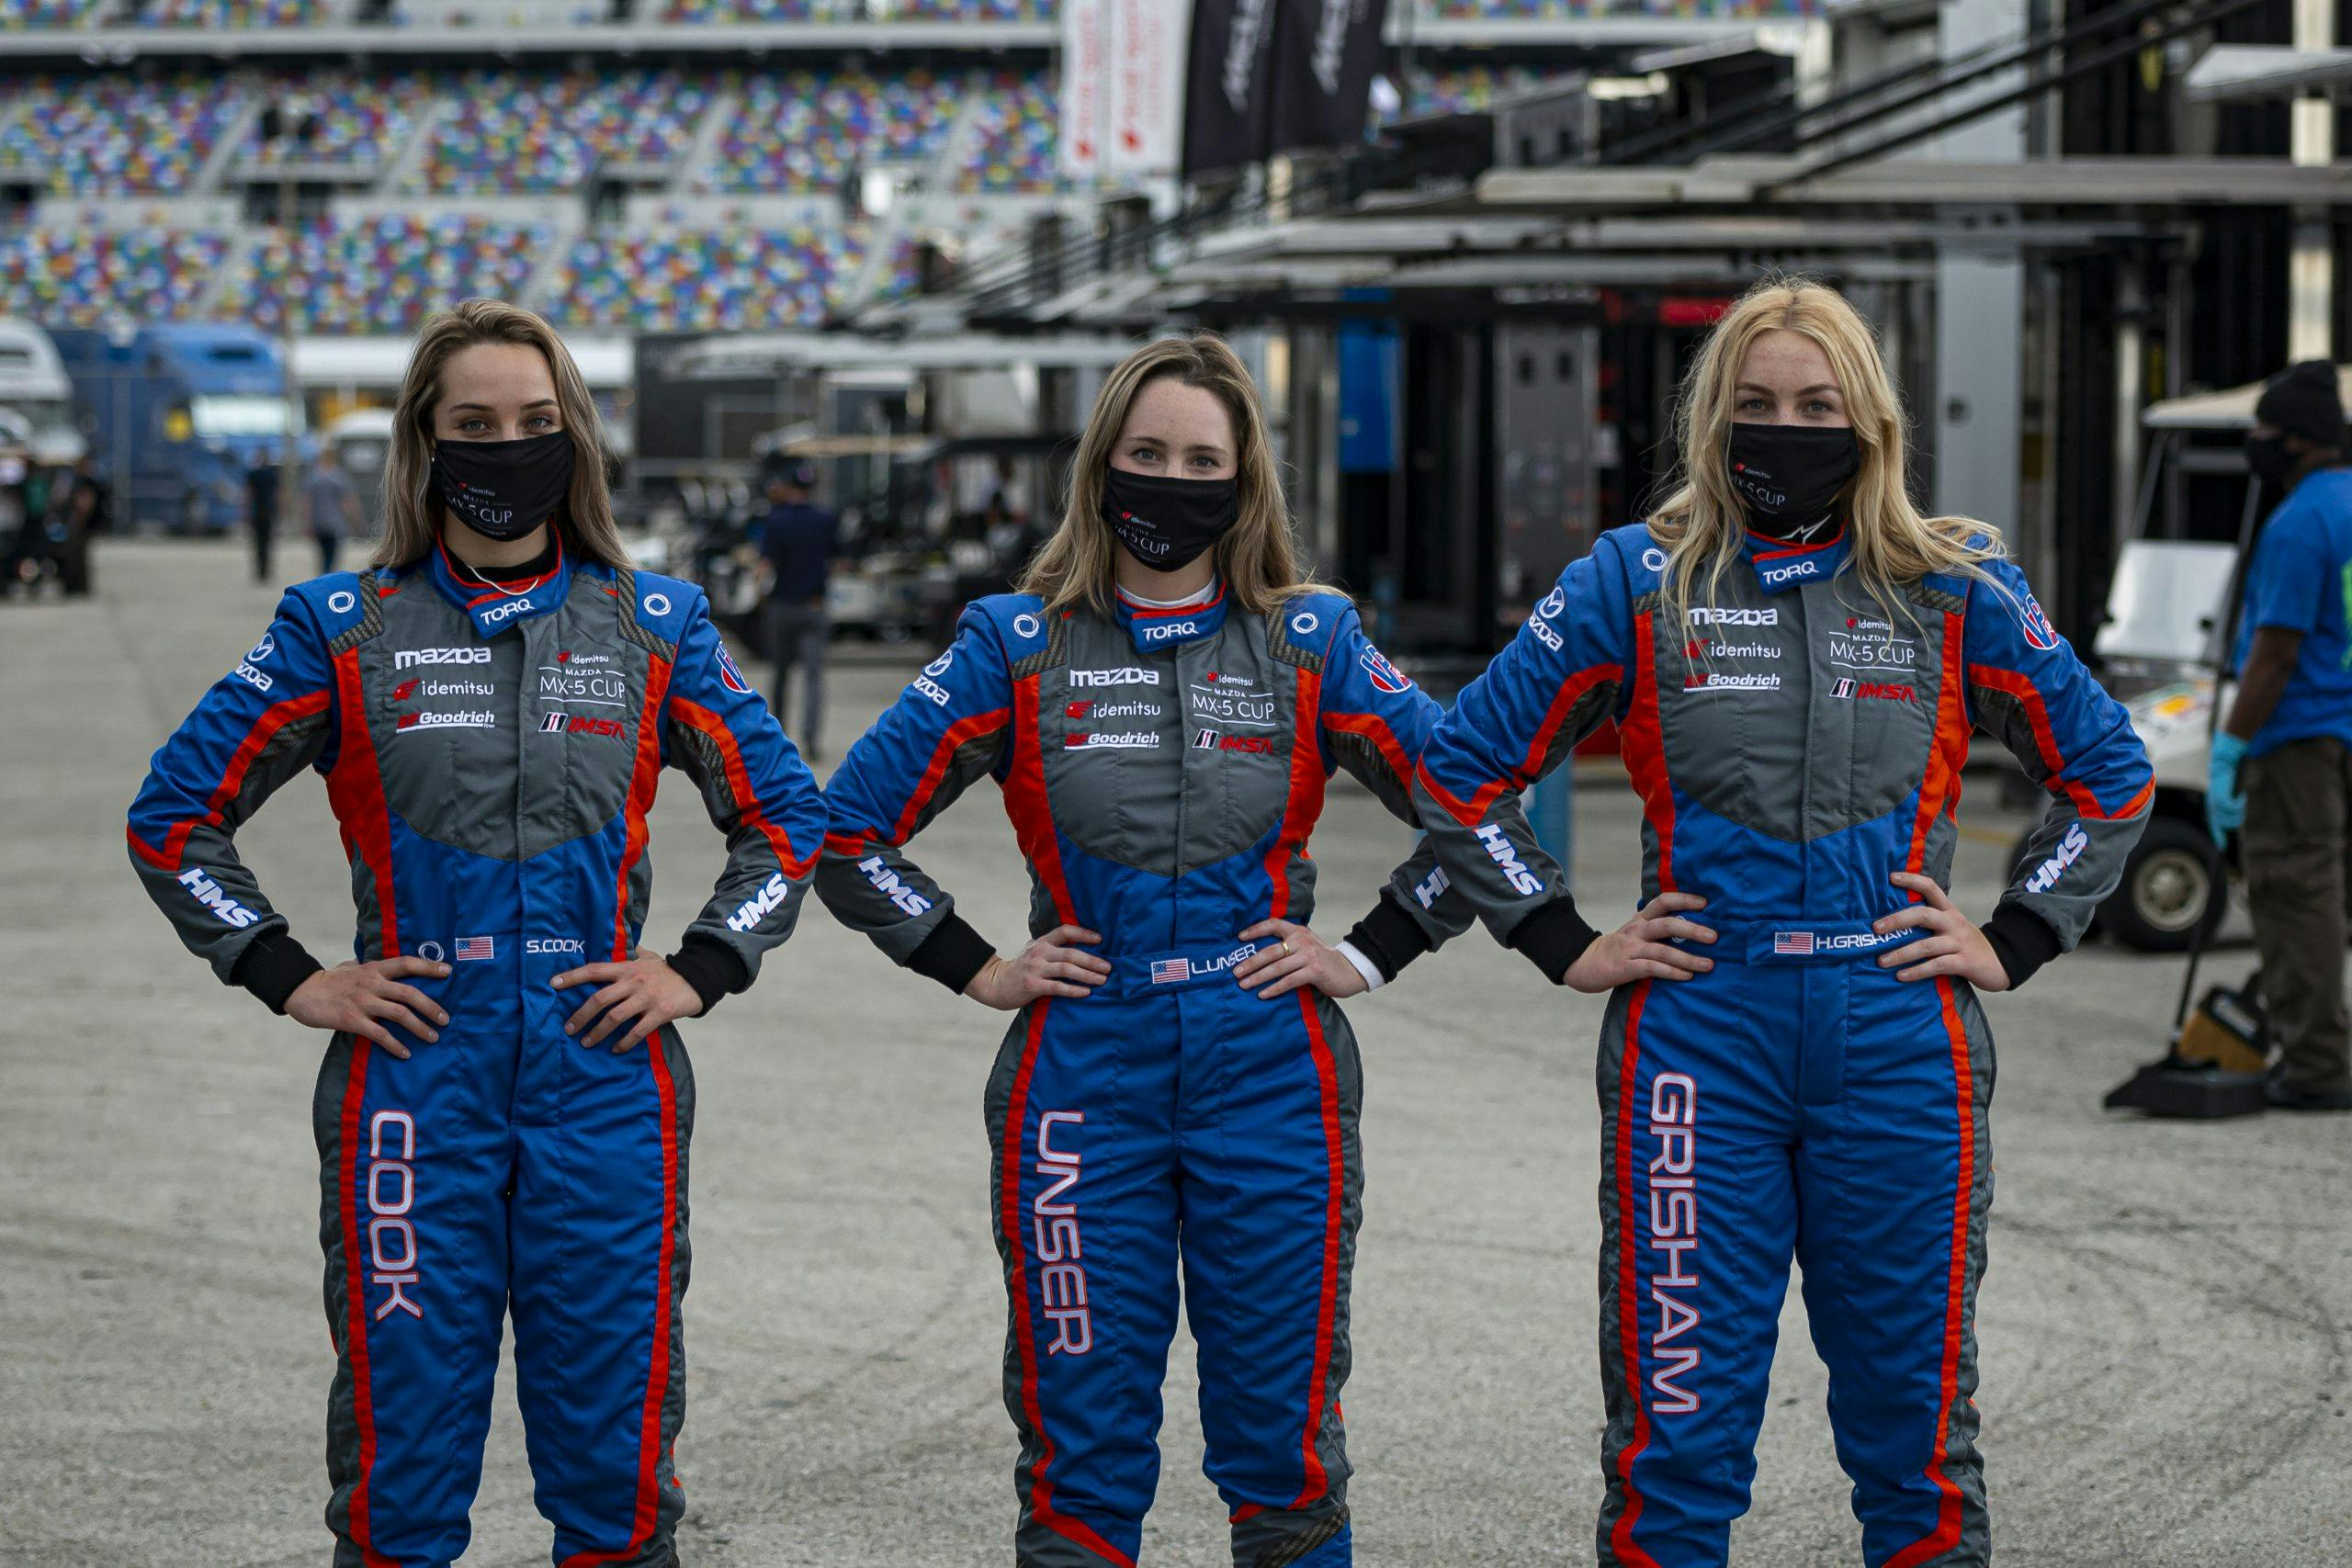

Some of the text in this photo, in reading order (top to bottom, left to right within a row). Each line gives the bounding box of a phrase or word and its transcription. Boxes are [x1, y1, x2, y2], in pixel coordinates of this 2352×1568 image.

[1757, 488, 1785, 506] CUP
[480, 508, 513, 524] CUP
[1140, 537, 1170, 555] CUP
[1763, 561, 1819, 585] TORQ
[481, 599, 535, 626] TORQ
[1142, 622, 1199, 642] TORQ
[1852, 634, 1887, 642] MAZDA
[571, 654, 609, 664] idemitsu
[1711, 641, 1781, 659] idemitsu
[1830, 640, 1916, 665] MX-5 CUP
[422, 680, 494, 695] idemitsu
[540, 676, 626, 698] MX-5 CUP
[1218, 674, 1253, 686] idemitsu
[1214, 688, 1247, 698] MAZDA
[1856, 682, 1918, 704] IMSA
[1093, 700, 1161, 718] idemitsu
[1193, 694, 1274, 719] MX-5 CUP
[567, 716, 627, 739] IMSA
[1218, 736, 1273, 754] IMSA
[1475, 823, 1543, 896] HMS
[2025, 823, 2087, 893] HMS
[858, 855, 932, 917] HMS
[178, 868, 259, 928] HMS
[726, 873, 788, 932] HMS
[526, 939, 586, 953] S.COOK
[1191, 943, 1258, 975] L.UNSER
[368, 1110, 424, 1321] COOK
[1035, 1111, 1093, 1356] UNSER
[1650, 1072, 1701, 1415] GRISHAM
